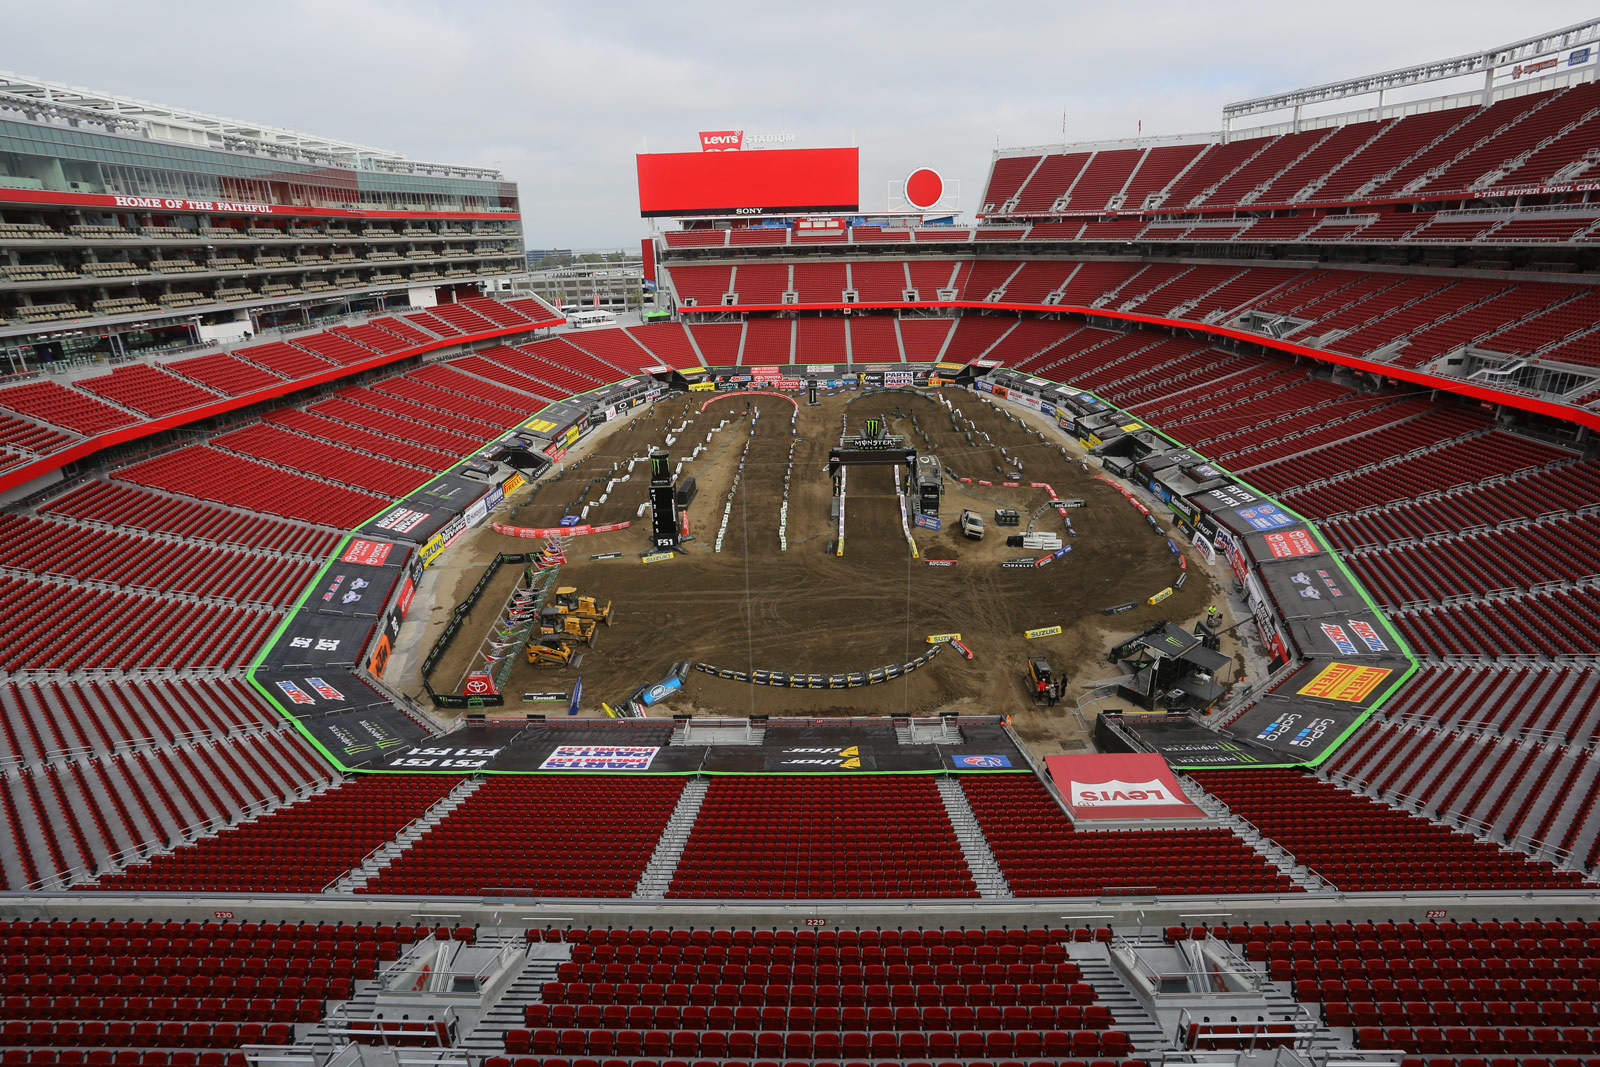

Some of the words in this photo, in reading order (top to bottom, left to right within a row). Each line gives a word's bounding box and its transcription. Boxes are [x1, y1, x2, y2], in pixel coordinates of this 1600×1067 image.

[1569, 57, 1587, 65] LIGHT
[746, 133, 796, 144] STADIUM
[1507, 188, 1540, 196] SUPER
[1542, 185, 1573, 194] BOWL
[115, 196, 162, 208] HOME
[165, 199, 184, 210] OF
[187, 200, 213, 211] THE
[217, 202, 273, 213] FAITHFUL
[1197, 522, 1212, 536] thor
[658, 538, 674, 546] FS1
[646, 554, 671, 562] SUZUKI
[1031, 627, 1058, 637] SUZUKI
[1348, 620, 1389, 652] AMSOIL
[1321, 623, 1360, 656] AMSOIL
[1306, 664, 1358, 697] PIRELLI
[1337, 667, 1390, 702] PIRELLI
[1266, 714, 1302, 742] GoPro
[1300, 718, 1335, 748] GoPro
[406, 748, 452, 756] FS1
[454, 748, 501, 756] FS1
[390, 758, 435, 766] FS1
[439, 758, 488, 768] FS1
